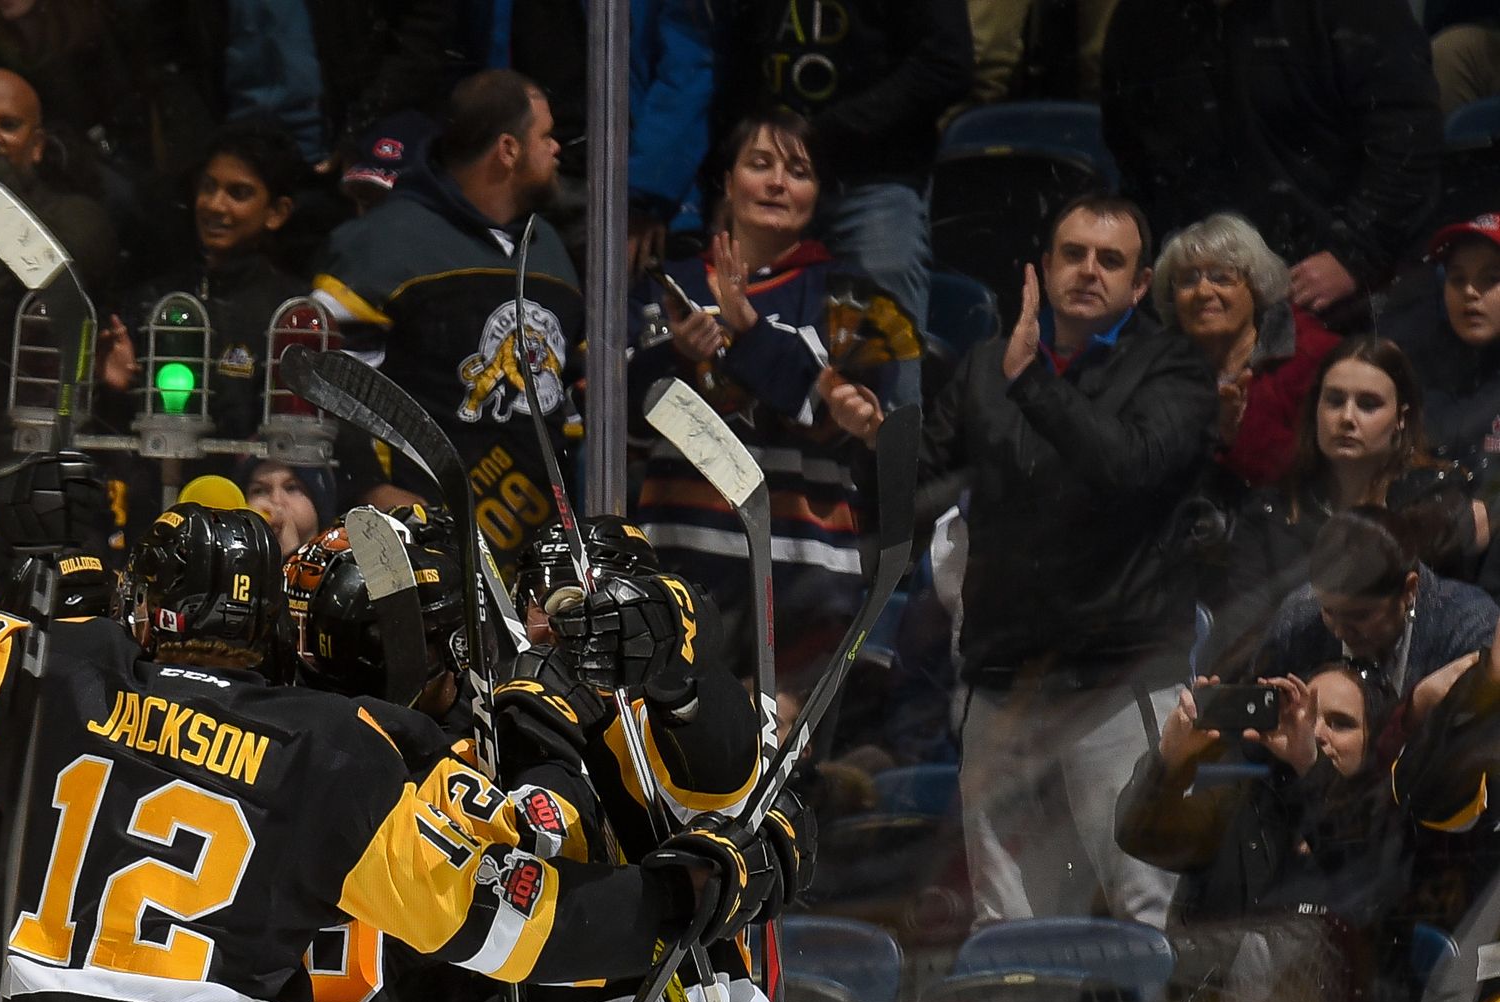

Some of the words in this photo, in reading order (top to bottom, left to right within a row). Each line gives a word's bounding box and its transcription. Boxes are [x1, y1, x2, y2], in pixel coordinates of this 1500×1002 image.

[58, 556, 103, 576] BULLDOGS
[232, 573, 251, 602] 12
[160, 667, 231, 688] CCM
[87, 691, 270, 785] JACKSON
[7, 753, 257, 982] 12
